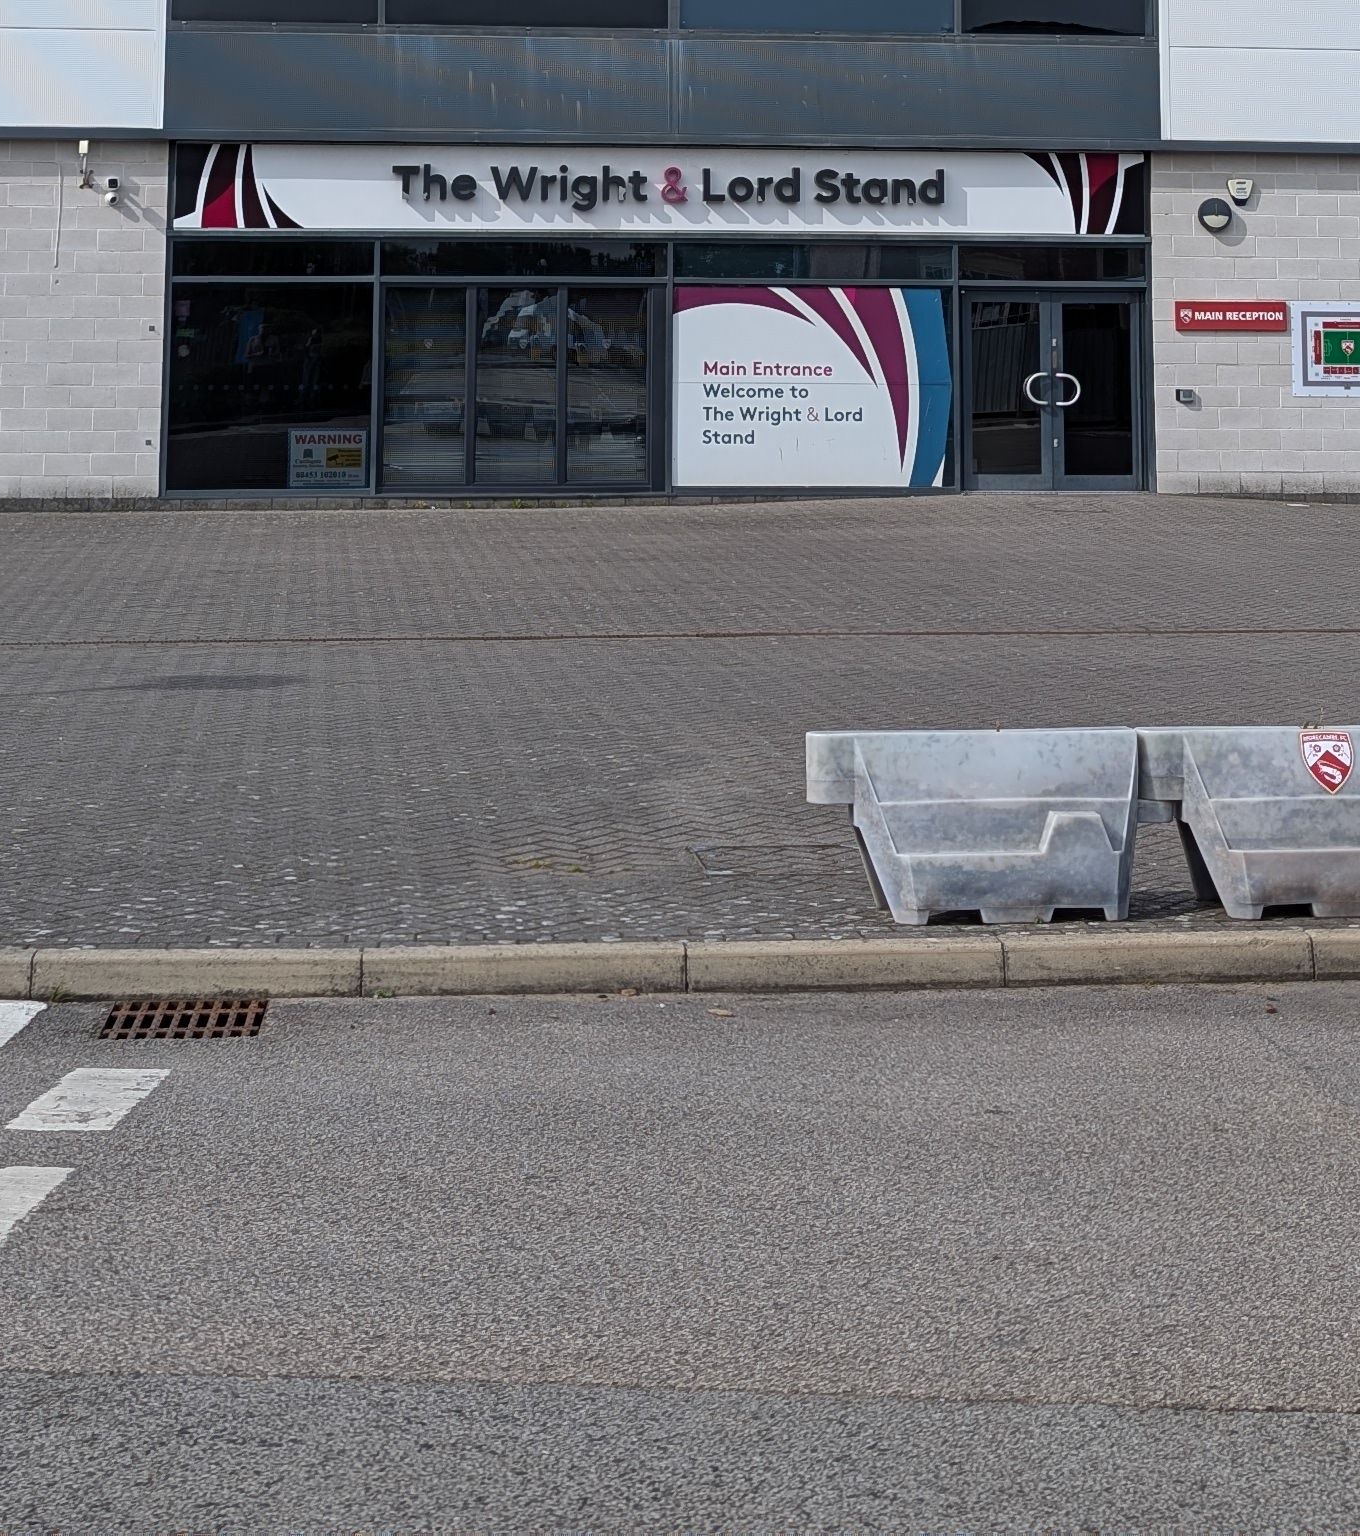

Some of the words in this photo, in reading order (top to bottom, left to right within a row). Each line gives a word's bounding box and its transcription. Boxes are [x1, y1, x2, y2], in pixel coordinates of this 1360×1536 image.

[393, 165, 477, 201] The
[490, 165, 648, 212] Wright
[660, 166, 689, 203] &
[703, 167, 801, 204] Lord
[813, 169, 945, 204] Stand
[1194, 311, 1223, 321] MAIN
[1226, 311, 1283, 321] RECEPTION
[703, 360, 747, 376] Main
[753, 361, 833, 376] Entrance
[703, 383, 784, 398] Welcome
[789, 385, 809, 398] to
[703, 406, 734, 421] The
[739, 406, 802, 426] Wright
[806, 406, 819, 422] &
[824, 407, 863, 422] Lord
[294, 434, 363, 444] WARNING
[702, 429, 755, 444] Stand
